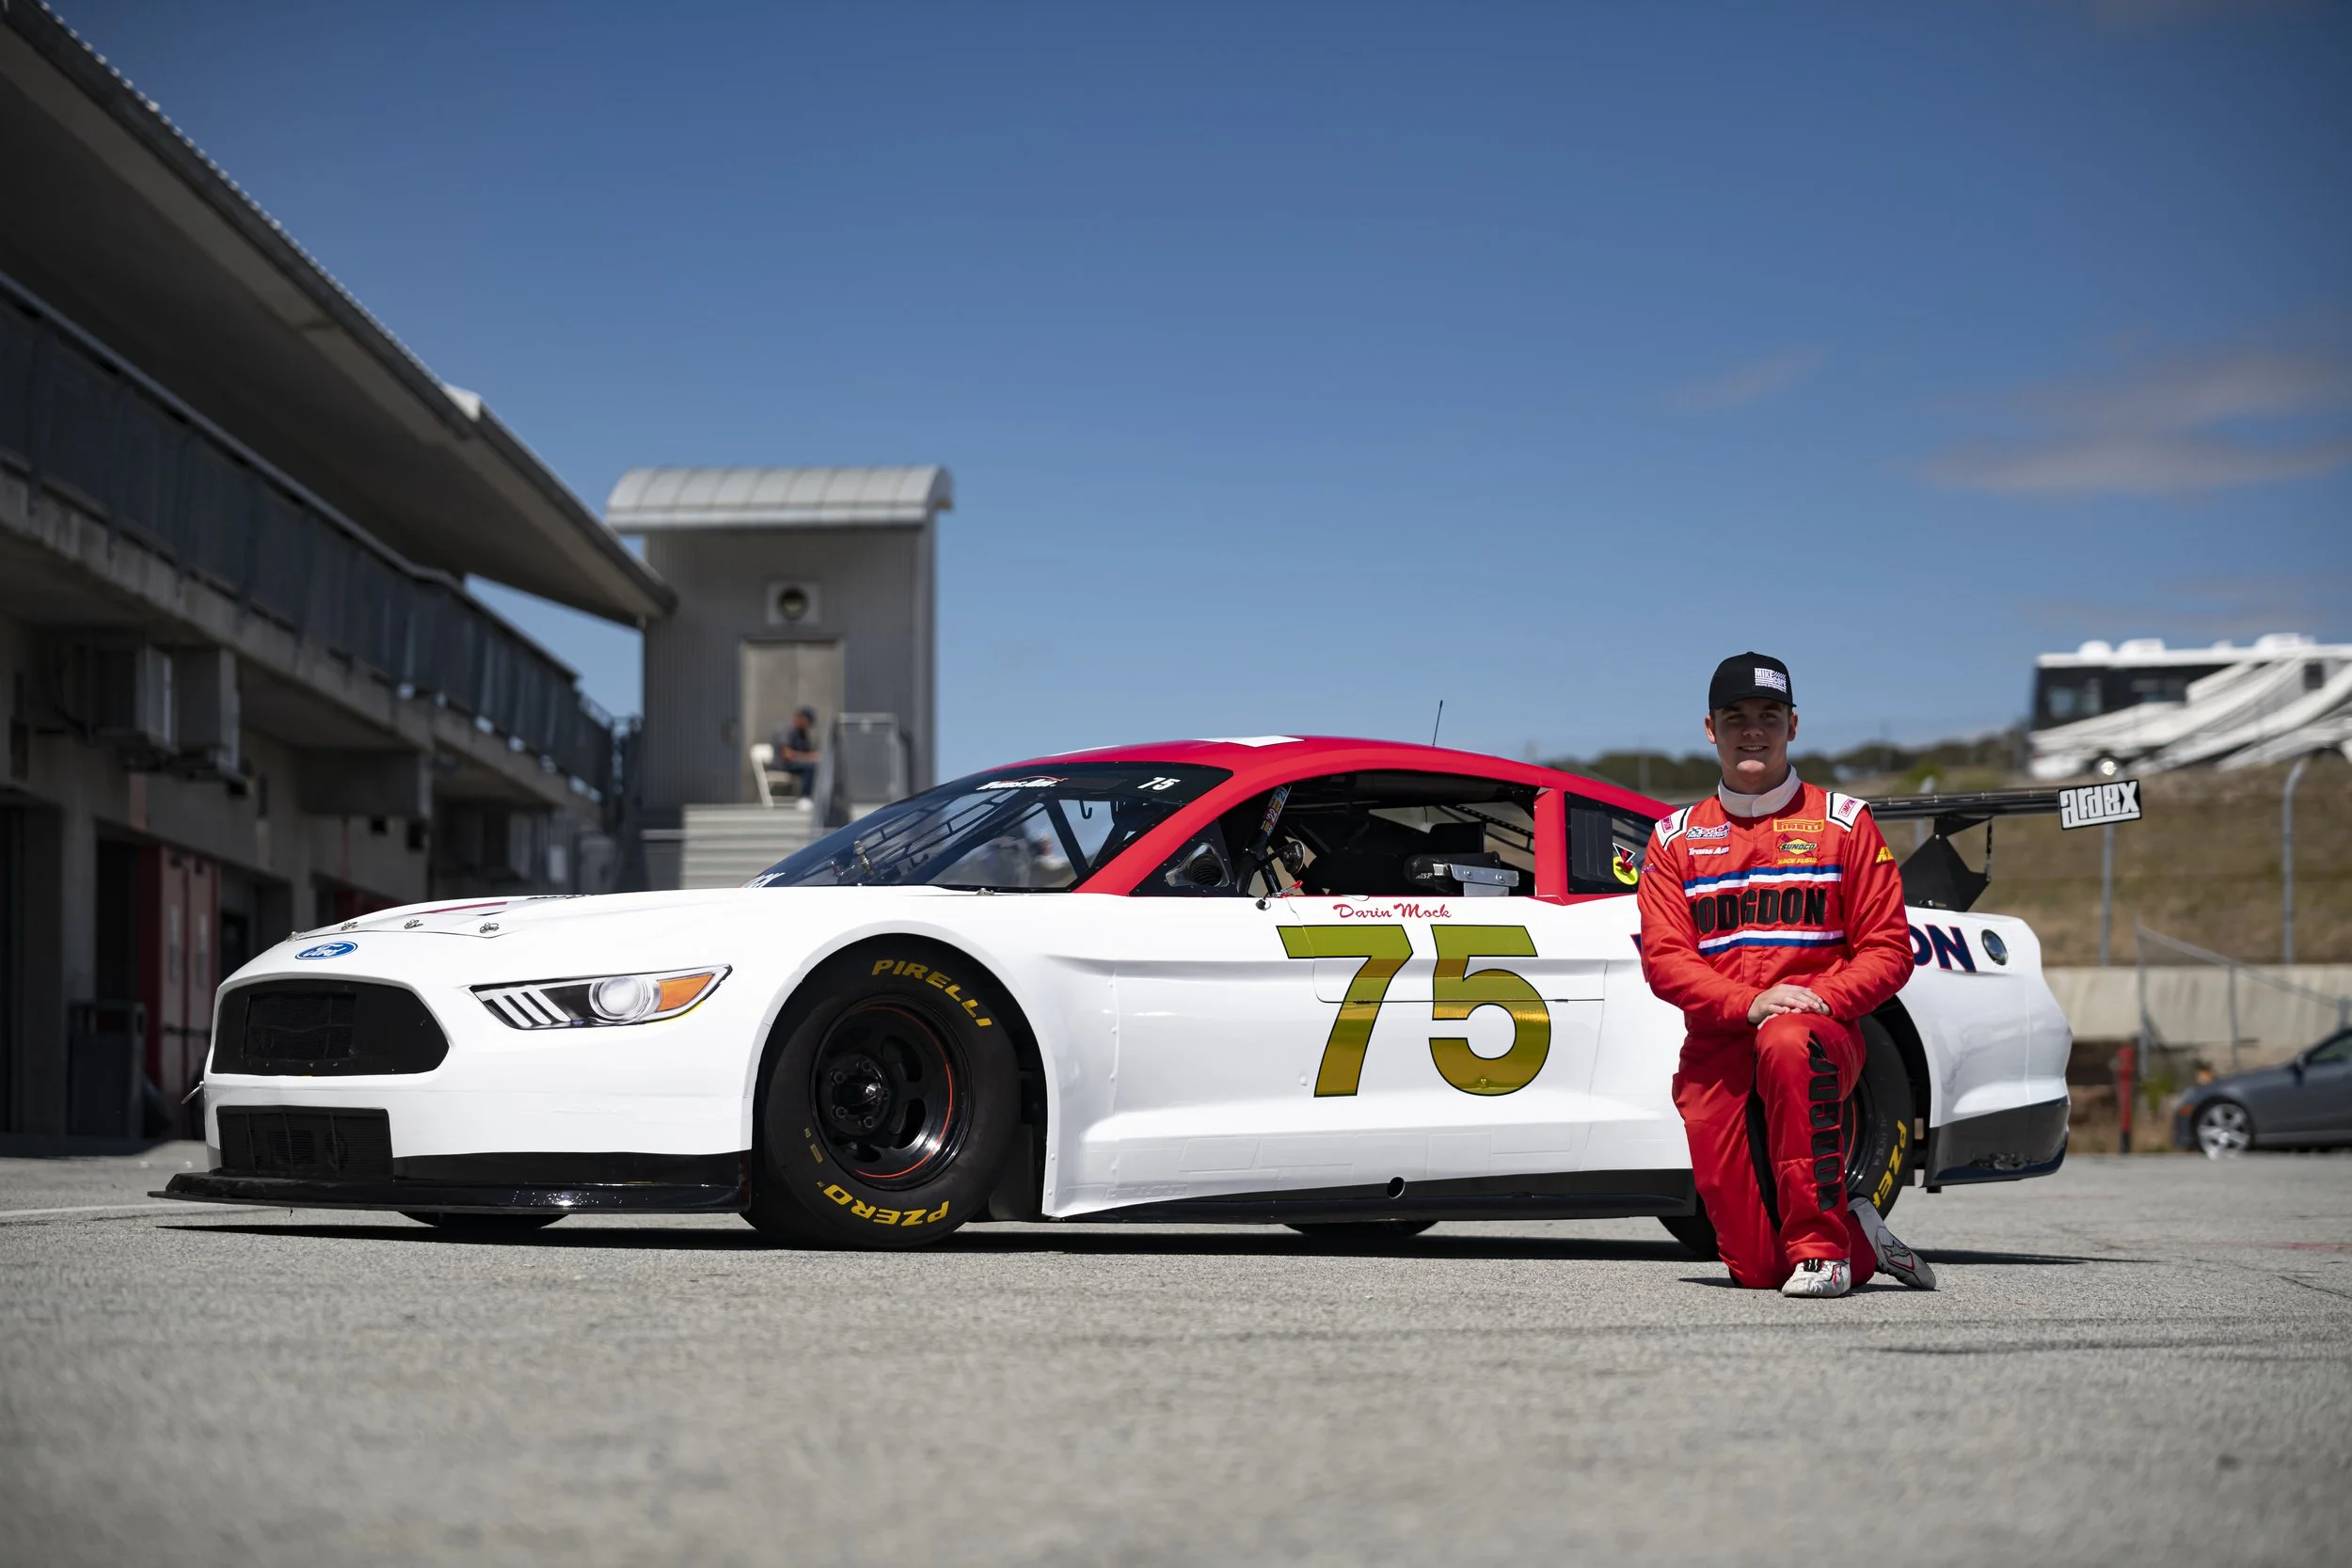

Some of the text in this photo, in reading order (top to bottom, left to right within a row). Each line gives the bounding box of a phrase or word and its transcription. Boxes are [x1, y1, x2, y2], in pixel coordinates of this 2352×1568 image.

[1136, 776, 1181, 791] 75
[1780, 842, 1817, 851] SUNOCO
[1332, 902, 1452, 919] Darin Mock
[301, 943, 347, 958] Ford
[872, 958, 993, 1028] PIRELLI
[1275, 923, 1551, 1099] 75
